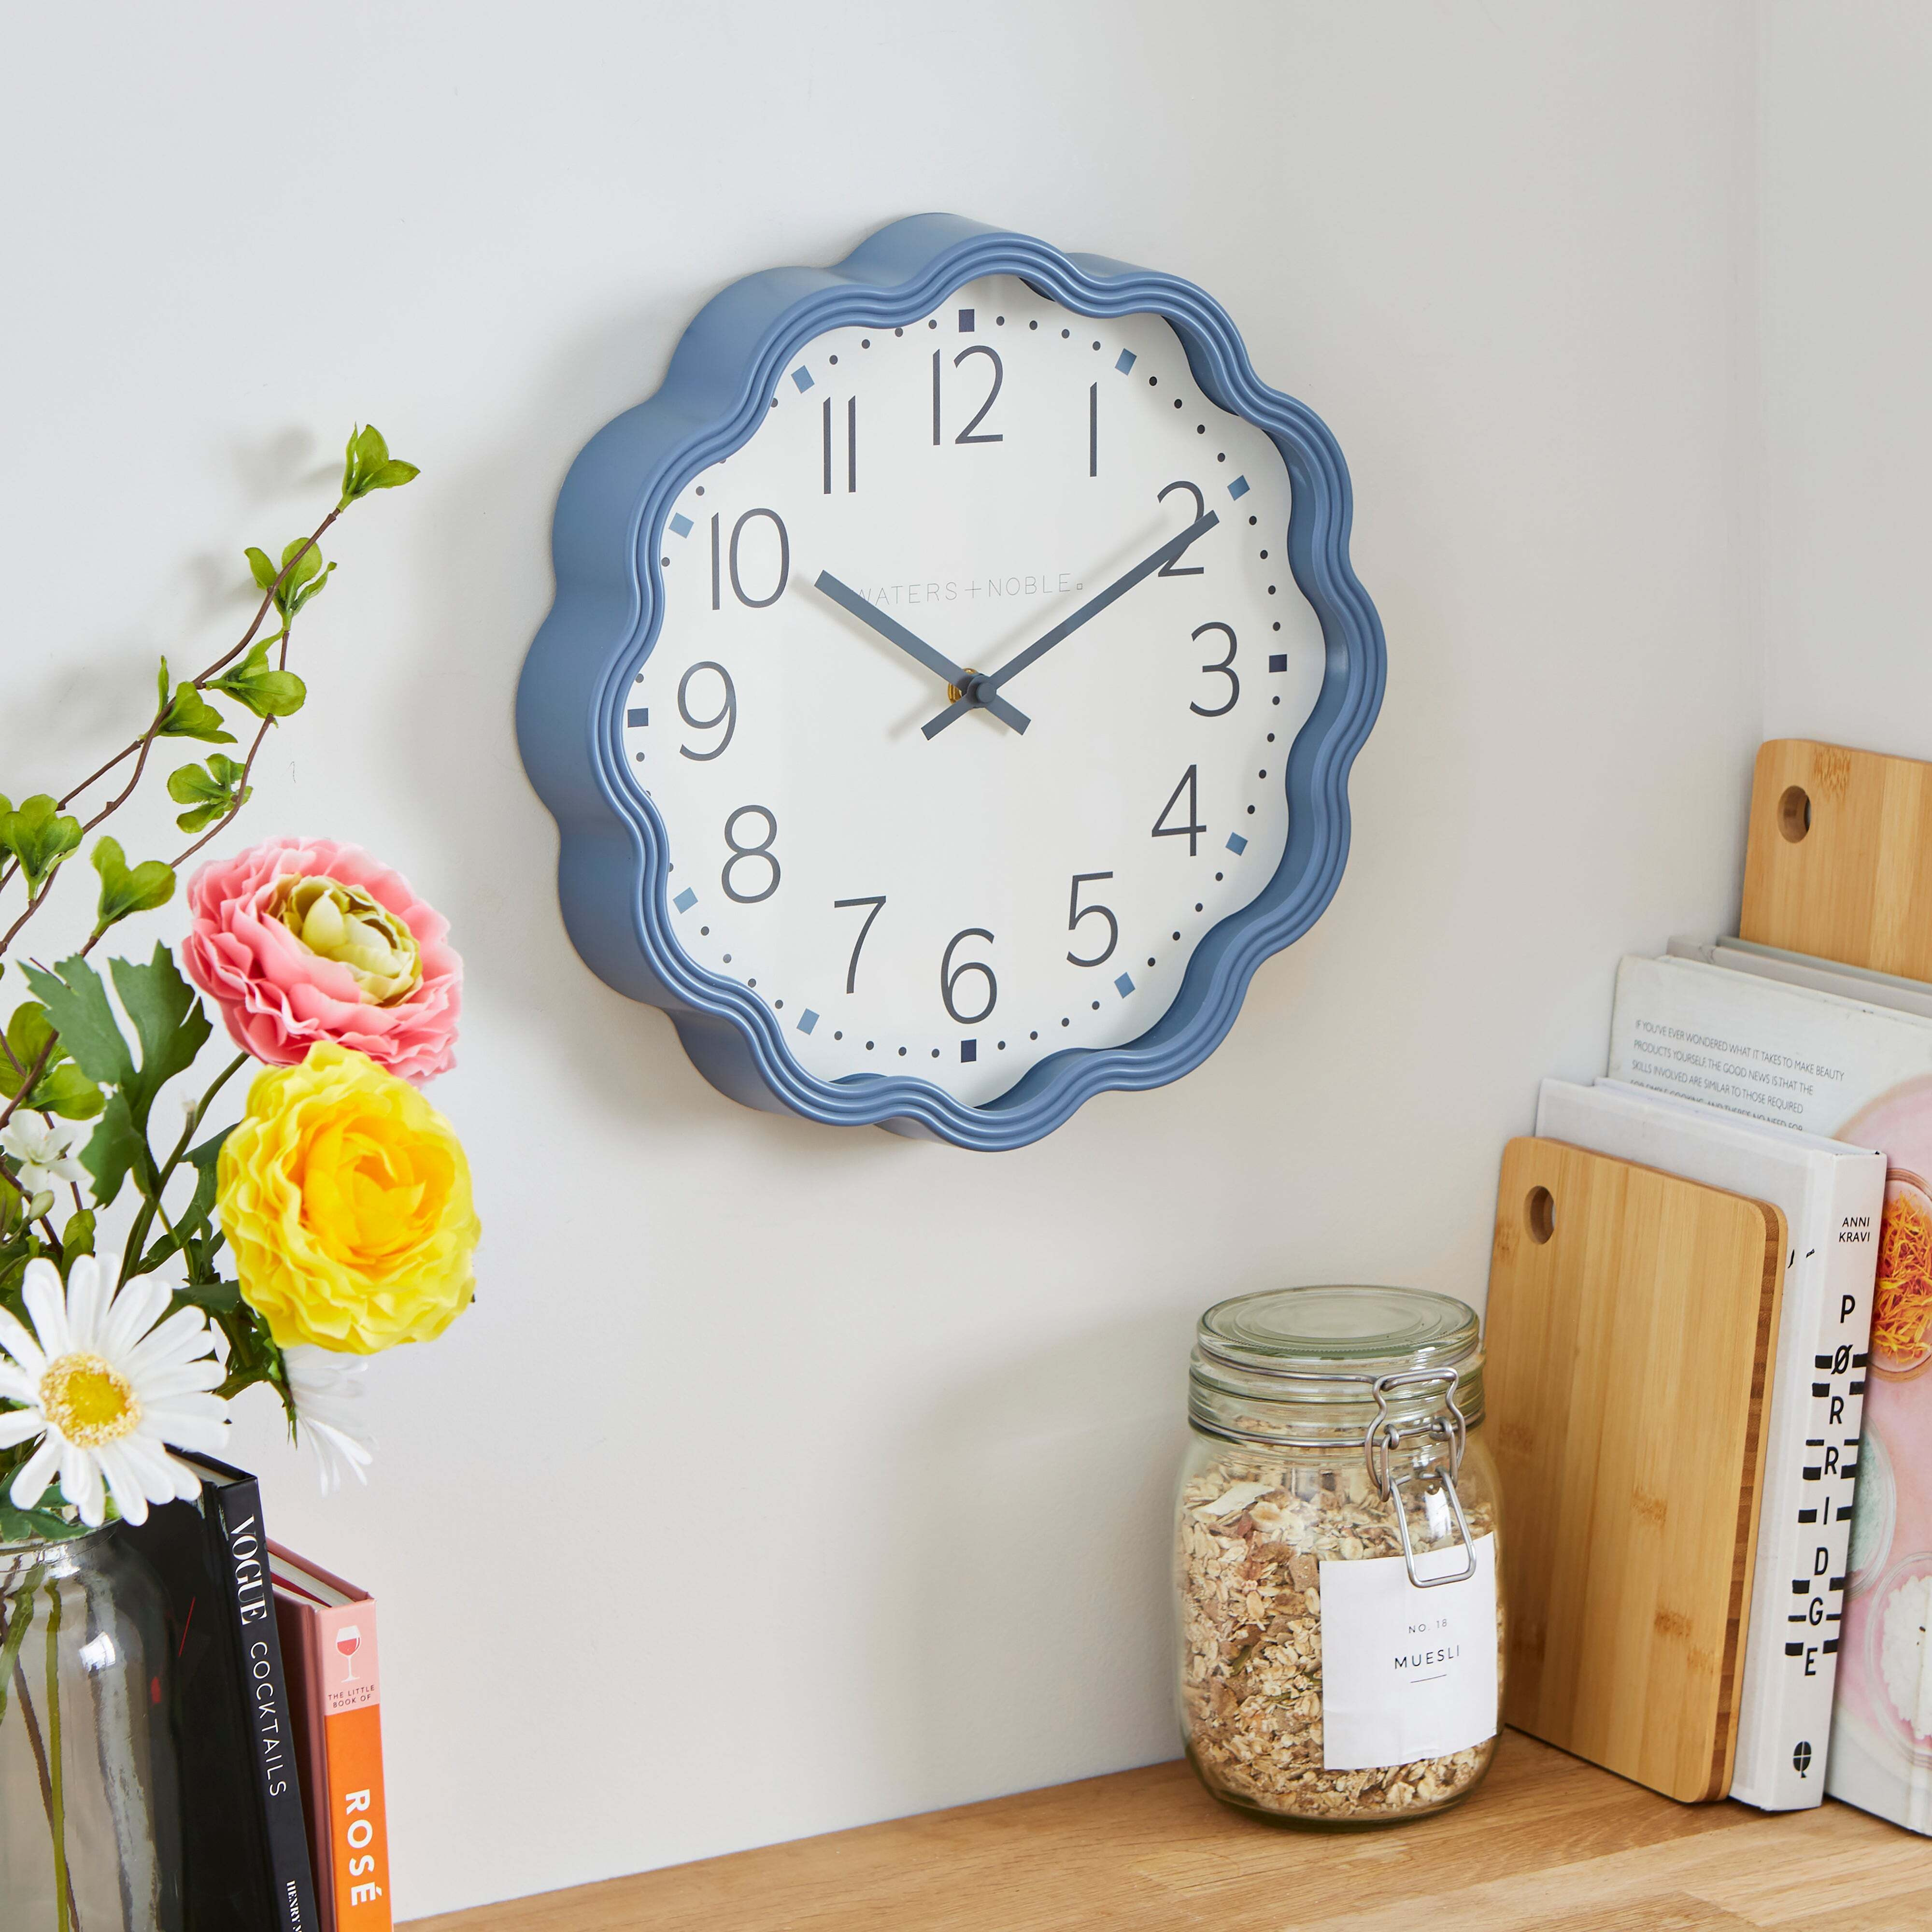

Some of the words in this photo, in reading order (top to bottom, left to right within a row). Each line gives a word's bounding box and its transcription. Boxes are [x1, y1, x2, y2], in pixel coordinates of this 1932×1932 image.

[933, 345, 1003, 446] 12
[1089, 382, 1098, 477] 1
[823, 395, 856, 495] 11
[711, 508, 790, 610] 10
[1157, 480, 1205, 578] 2
[677, 661, 737, 761] 9
[1189, 622, 1240, 717] 3
[721, 805, 781, 904] 8
[1151, 764, 1207, 857] 4
[834, 895, 886, 994] 7
[1066, 871, 1118, 967] 5
[940, 928, 997, 1024] 6
[1632, 1060, 1652, 1073] SKILLS
[1653, 1066, 1688, 1083] INVOLVED
[1688, 1075, 1703, 1087] ARE
[1704, 1079, 1730, 1094] SIMILAR
[1731, 1086, 1741, 1097] TO
[1743, 1090, 1765, 1103] THOSE
[1767, 1096, 1804, 1113] REQUIRED
[1634, 1040, 1671, 1057] PRODUCTS
[1707, 1059, 1721, 1070] THE
[1723, 1063, 1747, 1077] GOOD
[1748, 1069, 1770, 1083] NEWS
[1771, 1076, 1777, 1085] IS
[1778, 1077, 1797, 1090] THAT
[1799, 1082, 1814, 1094] THE
[1635, 1020, 1642, 1029] IF
[1668, 1028, 1685, 1040] EVER
[1686, 1033, 1728, 1051] WONDERED
[1729, 1044, 1751, 1057] WHAT
[1752, 1050, 1760, 1059] IT
[1761, 1052, 1781, 1065] TAKES
[1782, 1057, 1793, 1068] TO
[1794, 1061, 1815, 1073] MAKE
[1816, 1066, 1845, 1081] BEAUTY
[1839, 1232, 1870, 1242] KRAVI
[1842, 1217, 1870, 1227] ANNI
[231, 1515, 268, 1626] VOGUE
[1394, 1644, 1460, 1670] MUESLI
[1436, 1618, 1448, 1629] 18
[250, 1641, 287, 1796] COCKTAILS
[328, 1691, 344, 1700] THE
[348, 1684, 375, 1696] LITTLE
[333, 1697, 356, 1708] BOOK
[360, 1693, 371, 1702] OF
[345, 1788, 383, 1907] ROSÉ
[286, 1880, 300, 1922] HENRY
